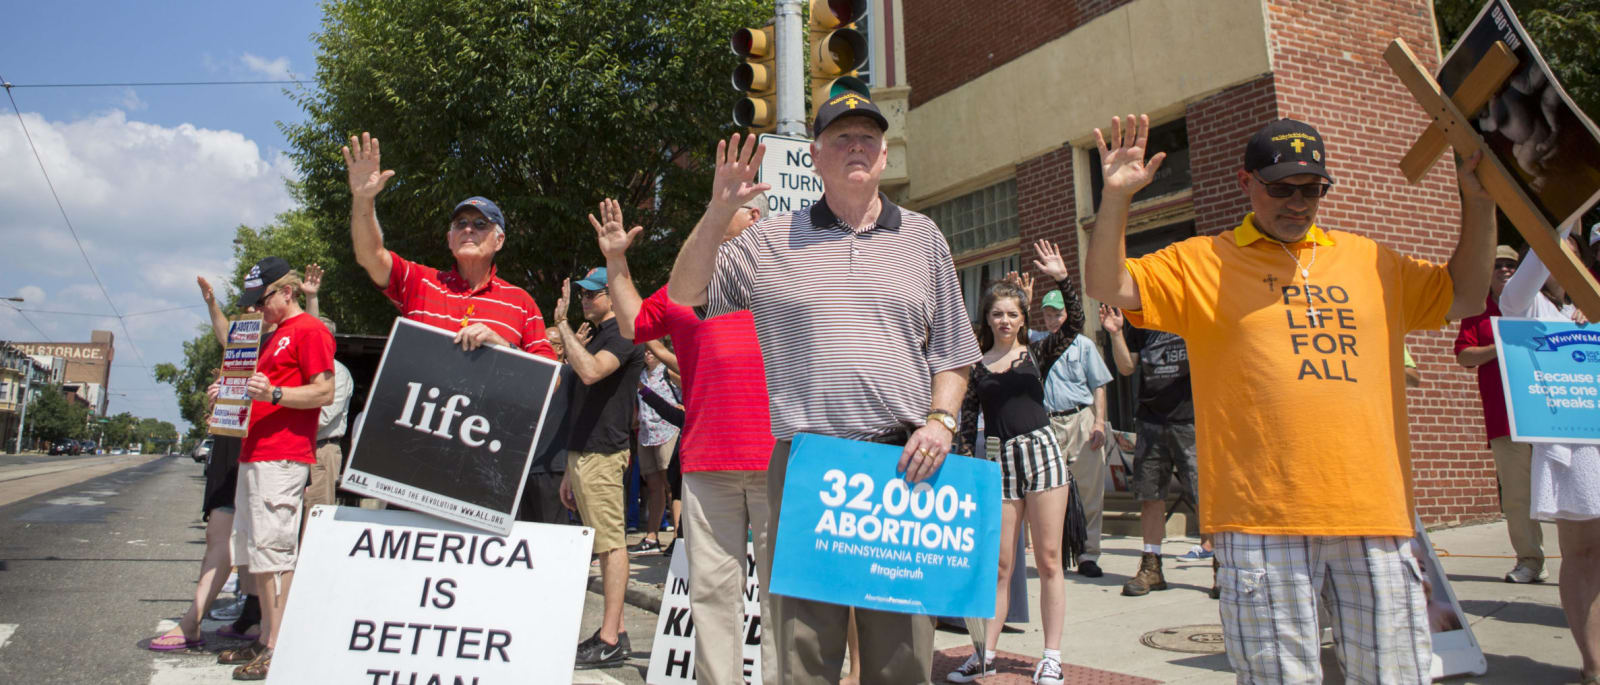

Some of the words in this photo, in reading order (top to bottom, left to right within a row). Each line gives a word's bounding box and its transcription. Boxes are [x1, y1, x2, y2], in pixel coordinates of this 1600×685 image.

[787, 150, 814, 168] NO
[779, 173, 823, 192] TURN
[768, 195, 790, 211] ON
[1282, 285, 1349, 305] PRO
[1286, 308, 1357, 330] LIFE
[1291, 333, 1359, 357] FOR
[1298, 359, 1358, 383] ALL
[1533, 370, 1593, 383] Because
[1528, 383, 1567, 397] stops
[1569, 385, 1598, 396] one
[1546, 397, 1594, 408] breaks
[394, 382, 501, 453] life.
[347, 474, 369, 487] ALL
[376, 481, 406, 496] DOWNLOAD
[408, 491, 419, 500] THE
[421, 494, 458, 511] REVOLUTION
[461, 506, 505, 526] WWW.ALL.ORG
[819, 469, 977, 522] 32,000+
[815, 509, 975, 552] ABORTIONS
[349, 528, 534, 570] AMERICA
[815, 538, 829, 551] IN
[832, 541, 912, 563] PENNSYLVANIA
[915, 552, 943, 566] EVERY
[946, 556, 970, 569] YEAR.
[870, 562, 924, 580] #tragictruth
[419, 577, 458, 610] IS
[348, 619, 512, 663] BETTER
